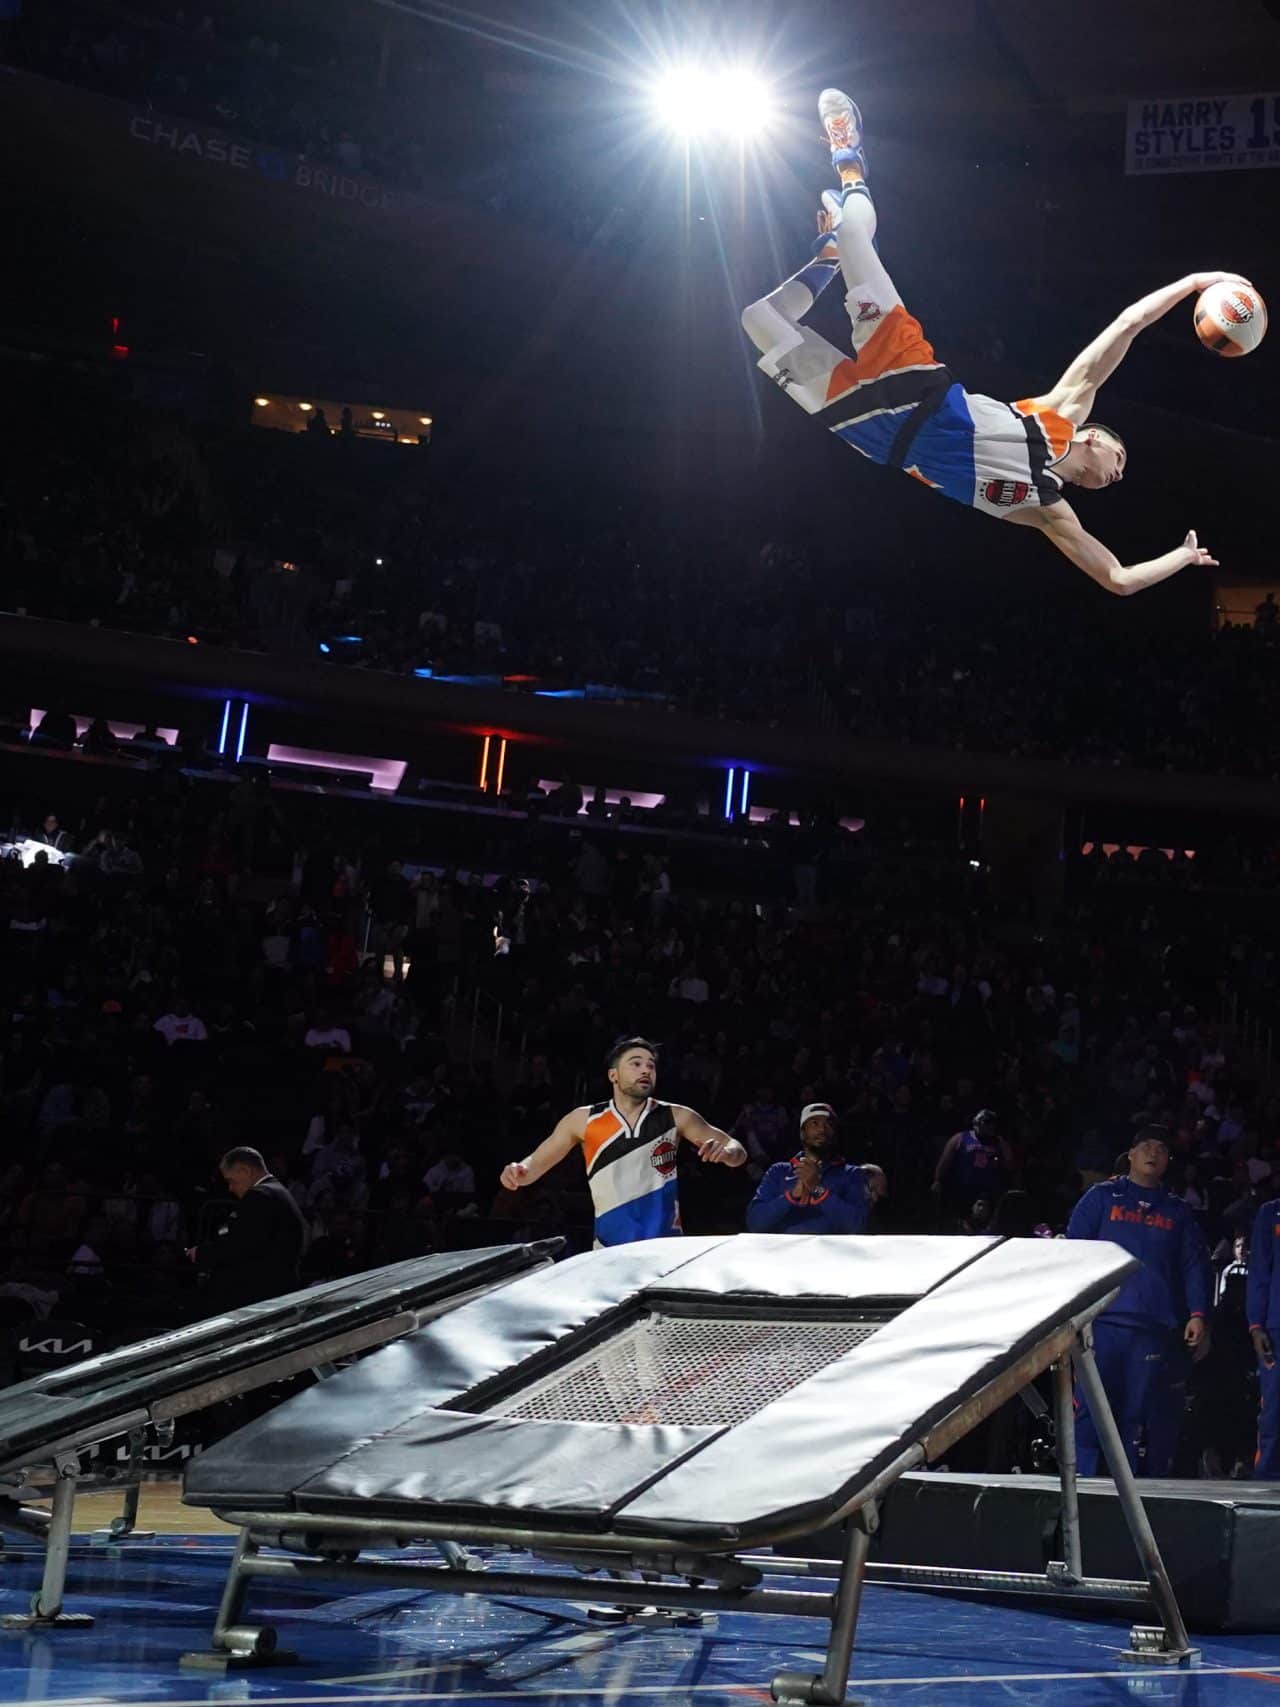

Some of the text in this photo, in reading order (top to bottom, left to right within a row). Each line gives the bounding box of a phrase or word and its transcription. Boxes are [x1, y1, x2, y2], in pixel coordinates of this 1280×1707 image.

[1142, 99, 1228, 129] HARRY
[129, 116, 250, 169] CHASE
[1135, 126, 1235, 155] STYLES
[19, 1336, 94, 1354] KIA
